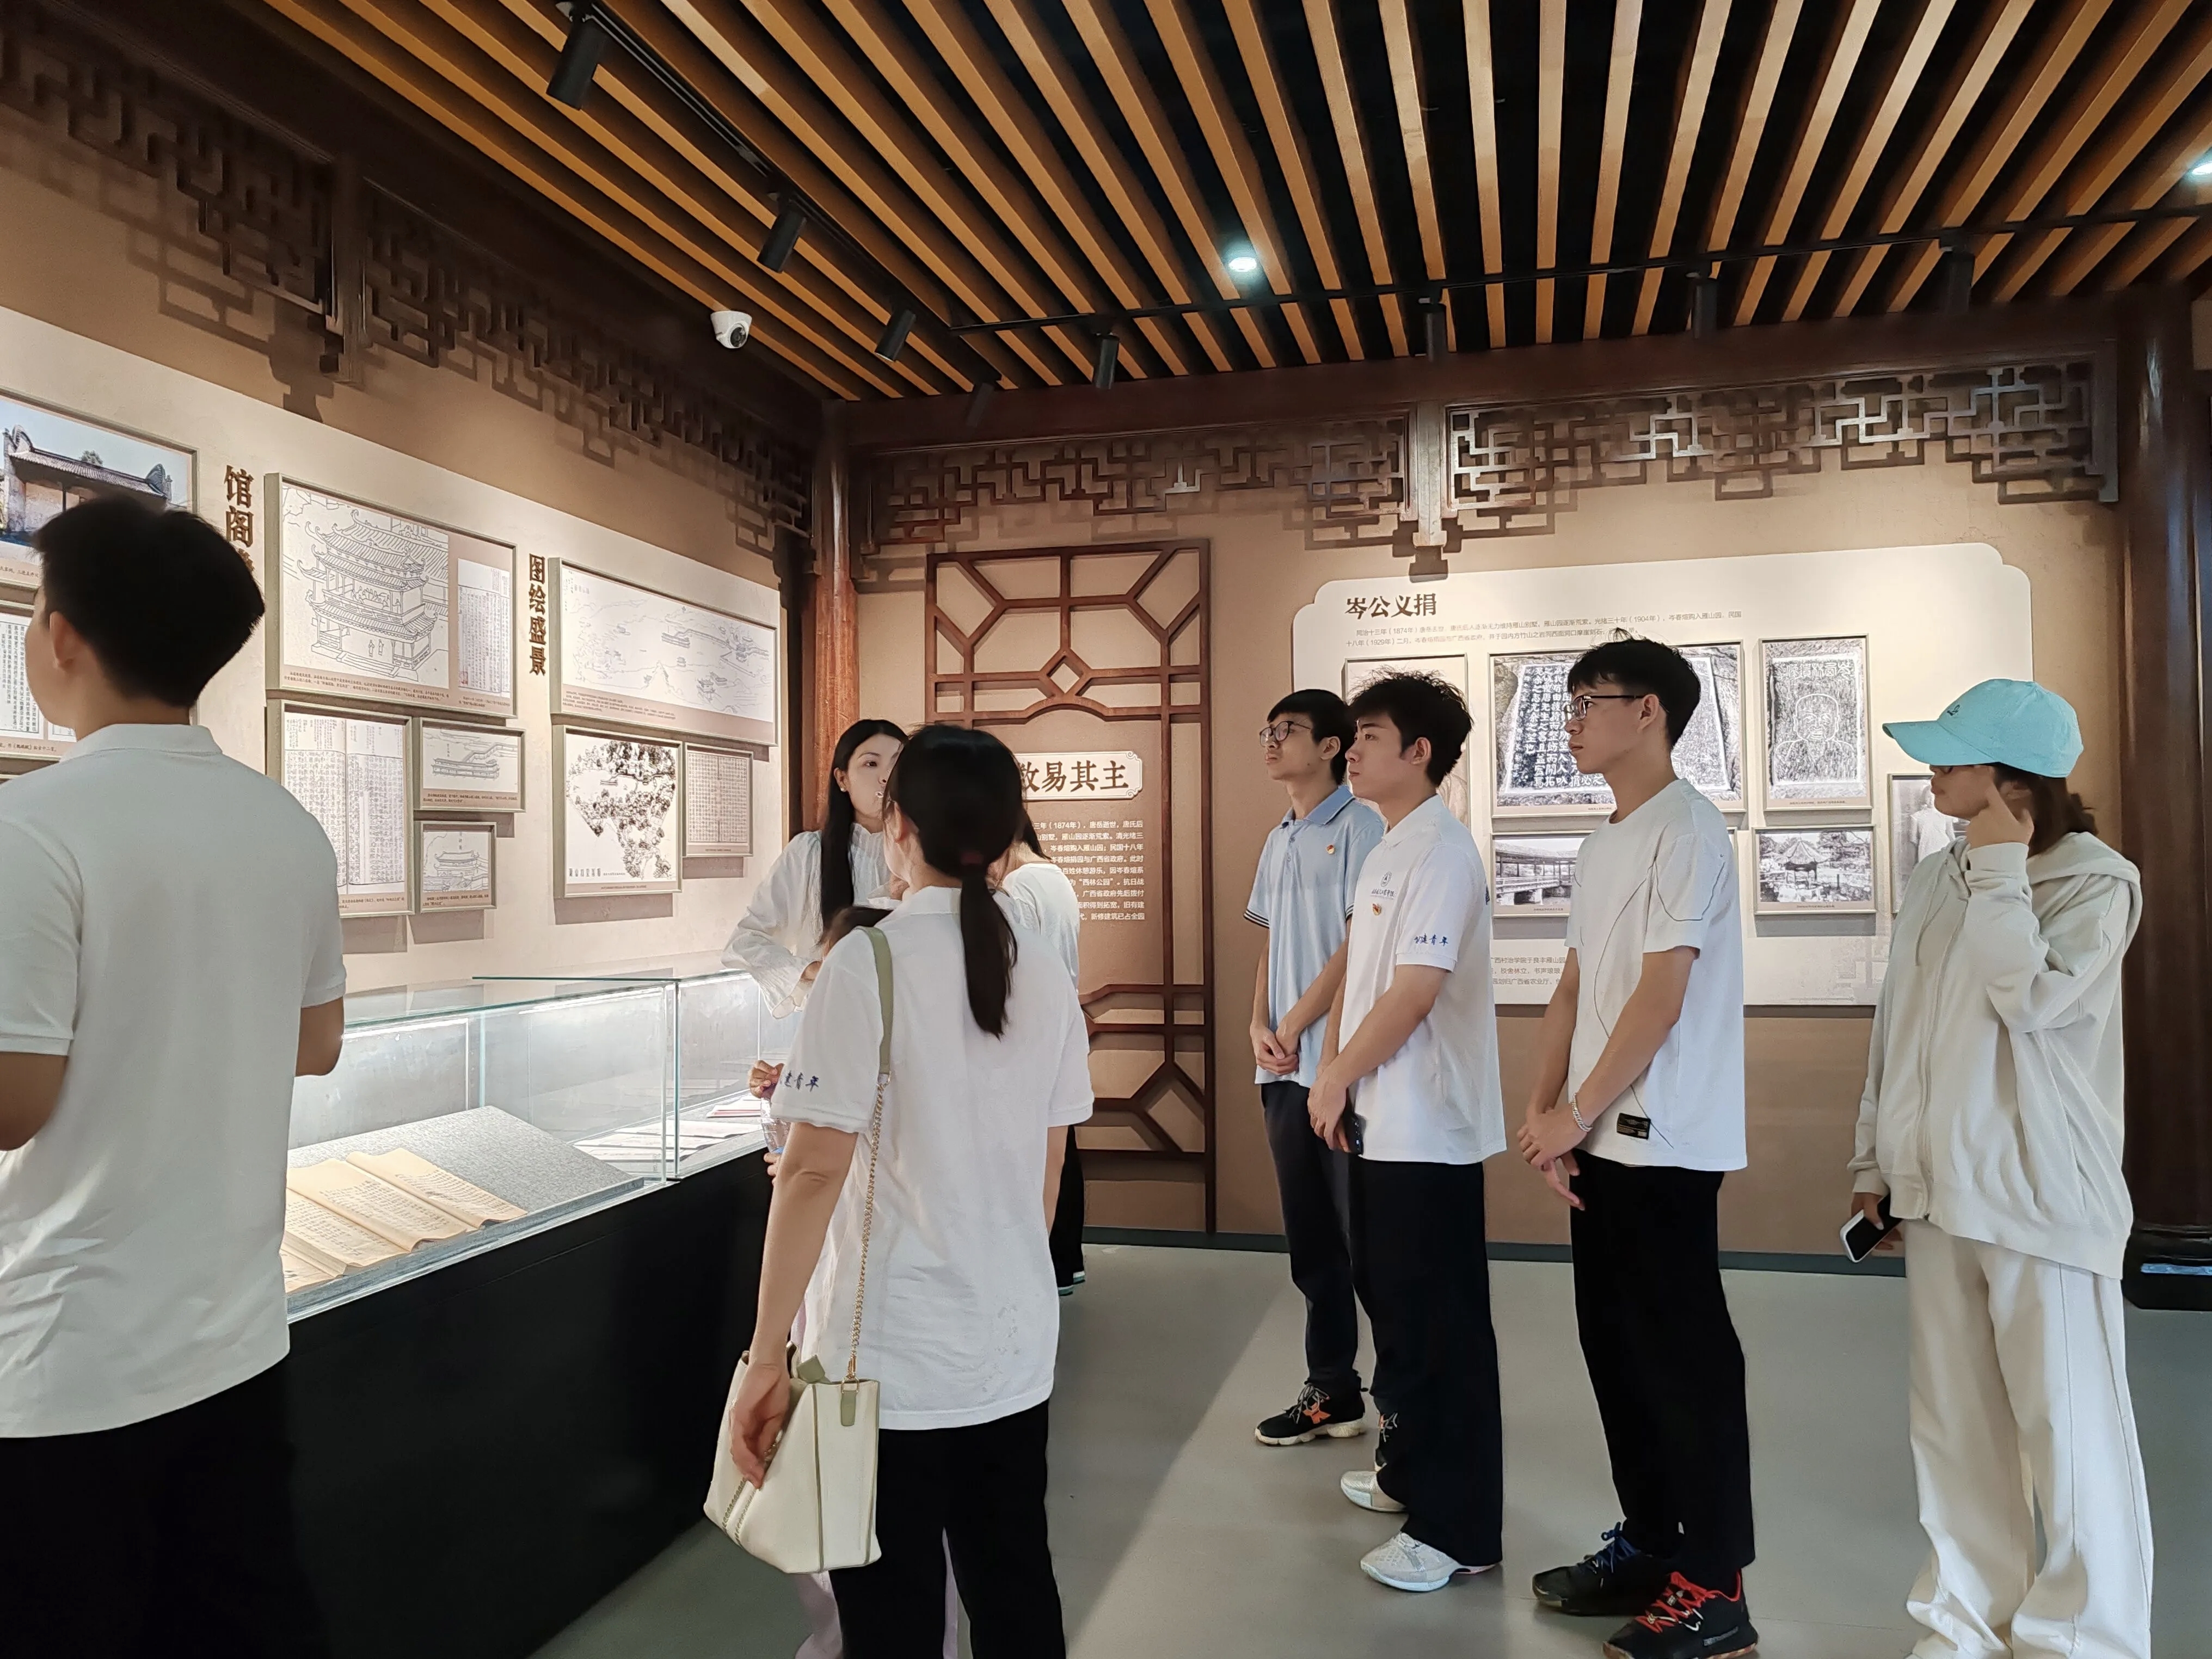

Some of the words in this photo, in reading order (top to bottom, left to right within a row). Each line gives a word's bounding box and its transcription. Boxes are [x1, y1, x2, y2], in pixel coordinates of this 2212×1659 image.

[224, 464, 255, 574] 馆阁
[529, 553, 546, 676] 图绘盛景
[1344, 593, 1437, 620] 岑公义捐
